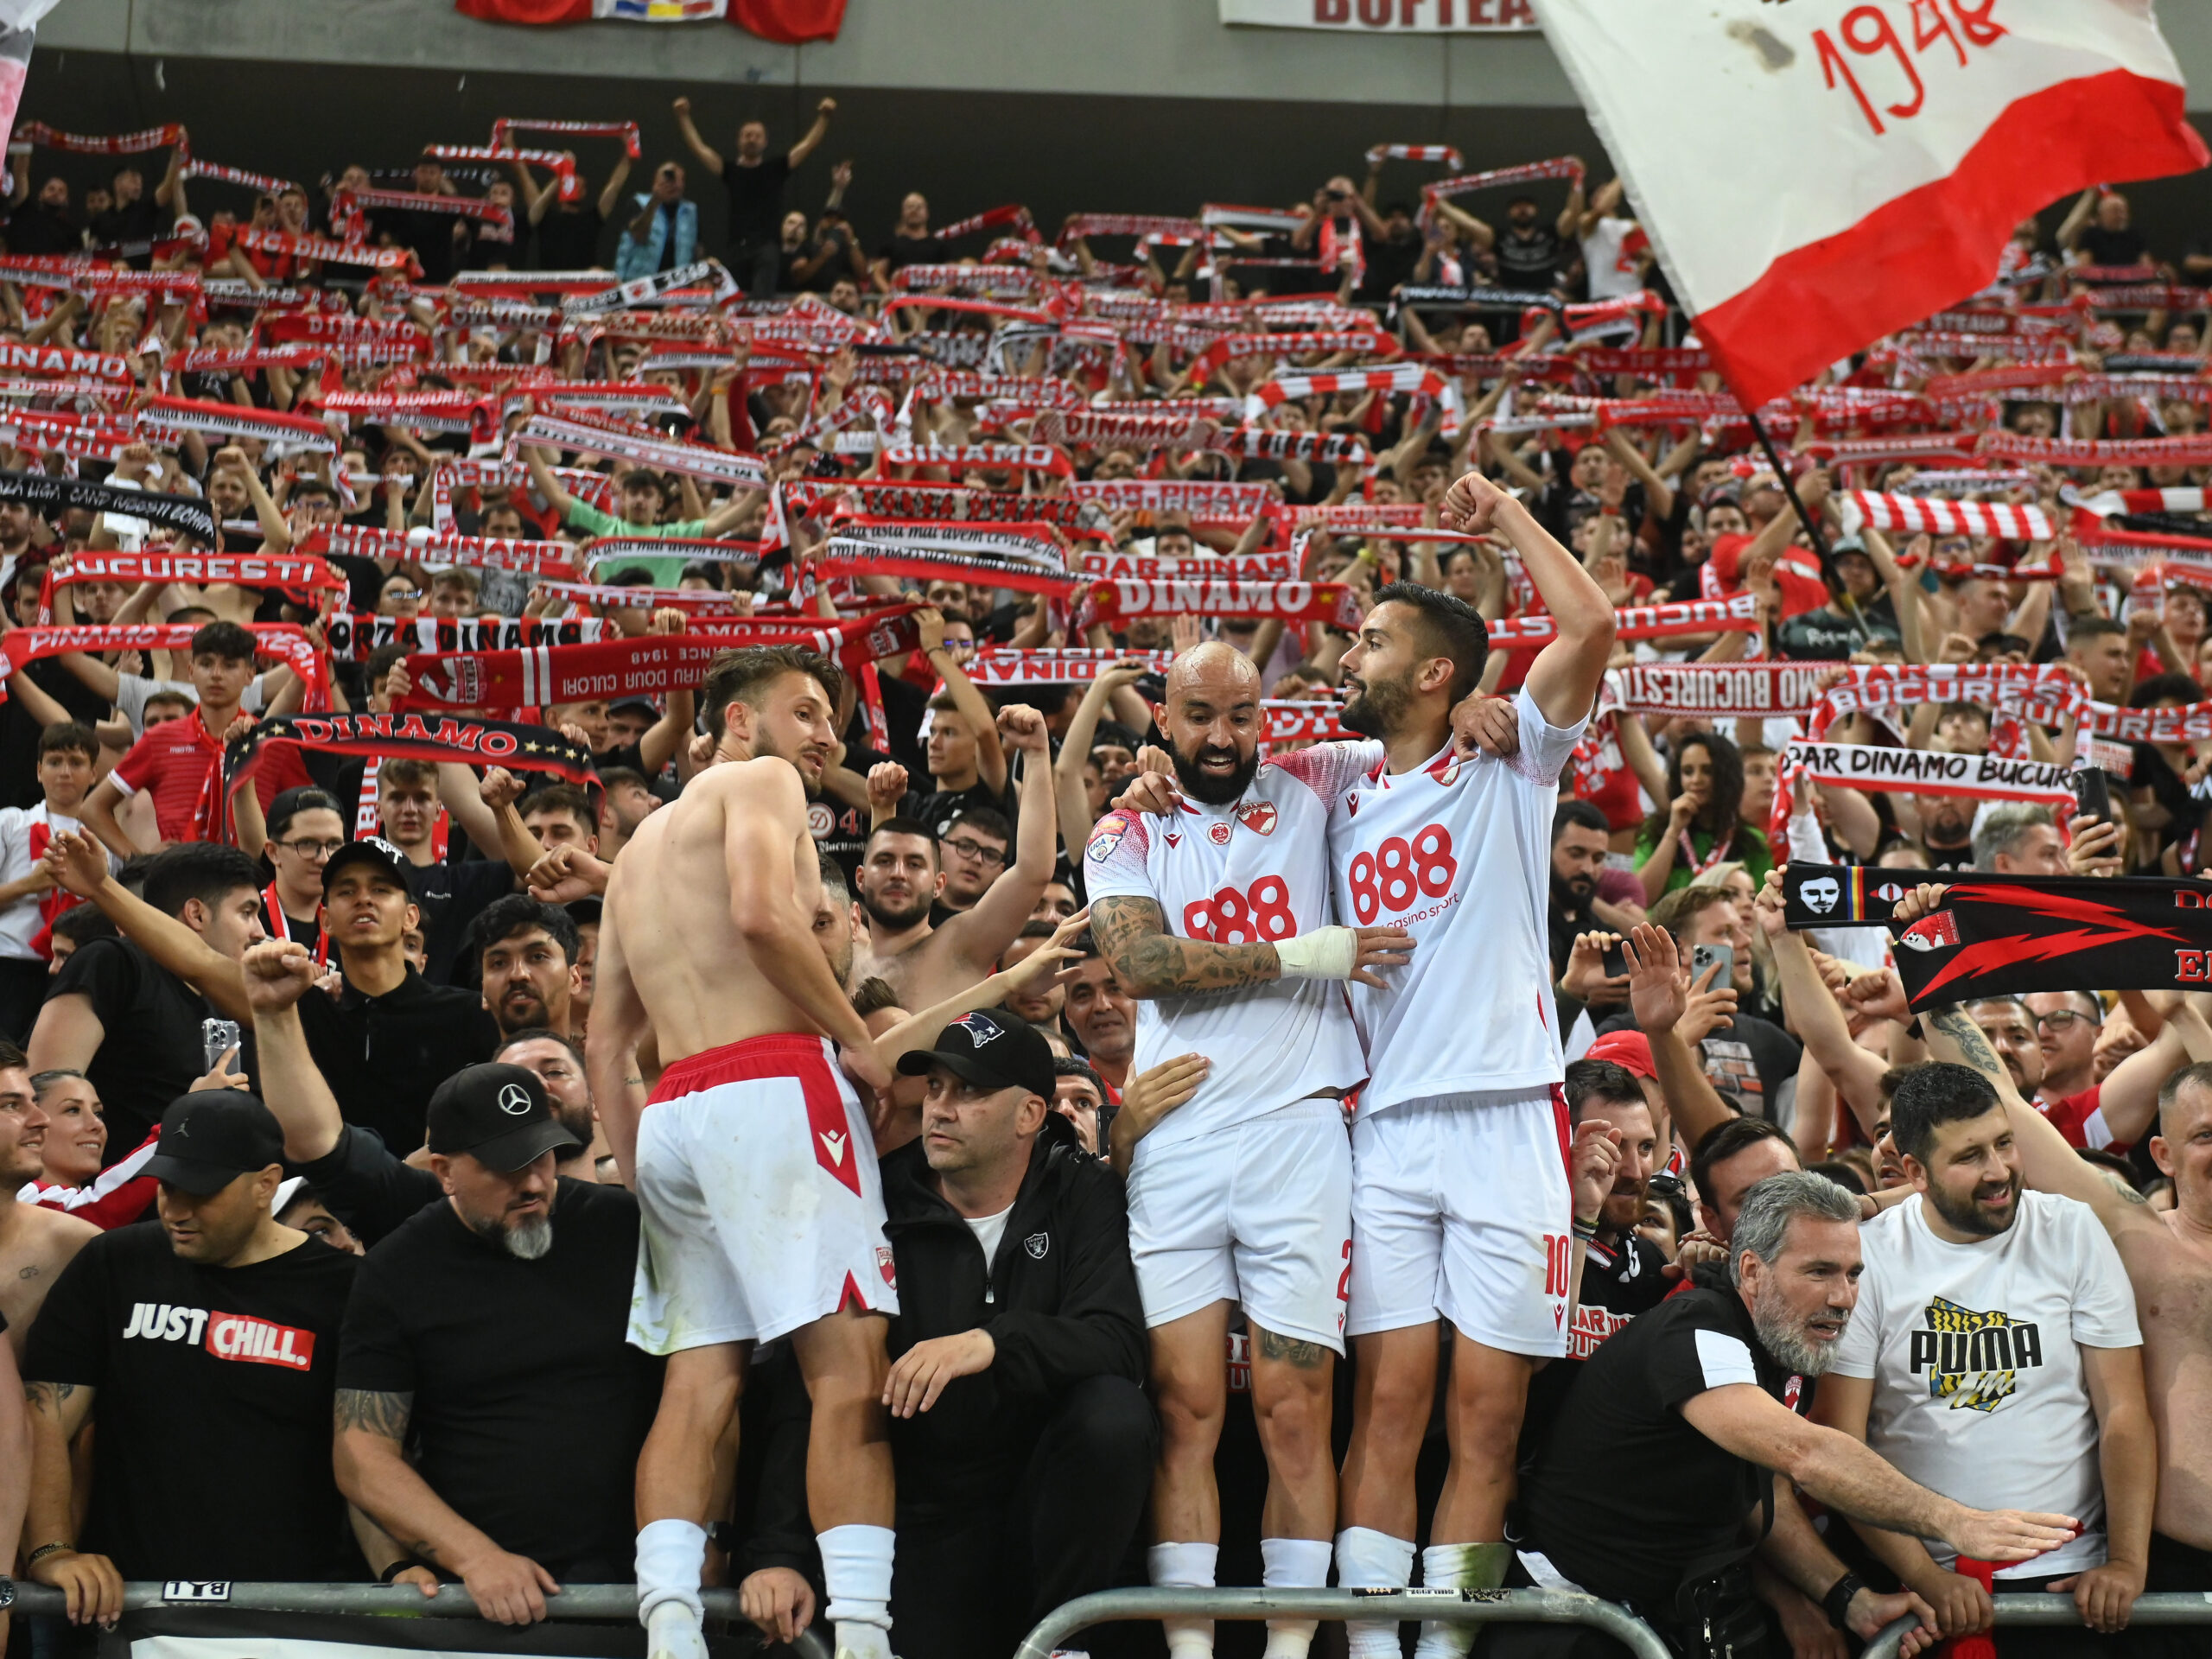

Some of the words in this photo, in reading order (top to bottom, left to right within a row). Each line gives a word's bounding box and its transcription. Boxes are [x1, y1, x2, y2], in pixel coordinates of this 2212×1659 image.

[294, 238, 397, 268] DINAMO
[1065, 415, 1191, 438] DINAMO
[889, 445, 1053, 466] DINAMO
[28, 484, 60, 499] LIGA
[864, 491, 955, 518] FORZA
[969, 497, 1079, 524] DINAMO
[871, 524, 905, 538] asta
[908, 523, 937, 538] mai
[942, 528, 983, 544] avem
[986, 531, 1021, 546] ceva
[1023, 533, 1042, 549] de
[862, 546, 881, 562] de
[1084, 556, 1160, 580] DAR
[1178, 555, 1290, 580] DINAM
[1119, 579, 1313, 614] DINAMO
[29, 626, 159, 654] DINAMO
[436, 619, 582, 652] DINAMO
[632, 652, 669, 664] 1948
[563, 673, 619, 696] CULORI
[1621, 665, 1773, 711] BUCURESTI
[292, 713, 518, 758] DINAMO
[1852, 749, 1968, 780] DINAMO
[1090, 838, 1107, 853] LIGA
[1348, 823, 1458, 926] 888
[1183, 874, 1298, 944] 888
[1387, 912, 1427, 929] casino
[1428, 892, 1459, 918] sport
[2173, 949, 2212, 982] E
[1543, 1233, 1569, 1299] 10
[123, 1303, 209, 1345] JUST
[214, 1319, 308, 1366] CHILL.
[1910, 1322, 2044, 1375] PUMA
